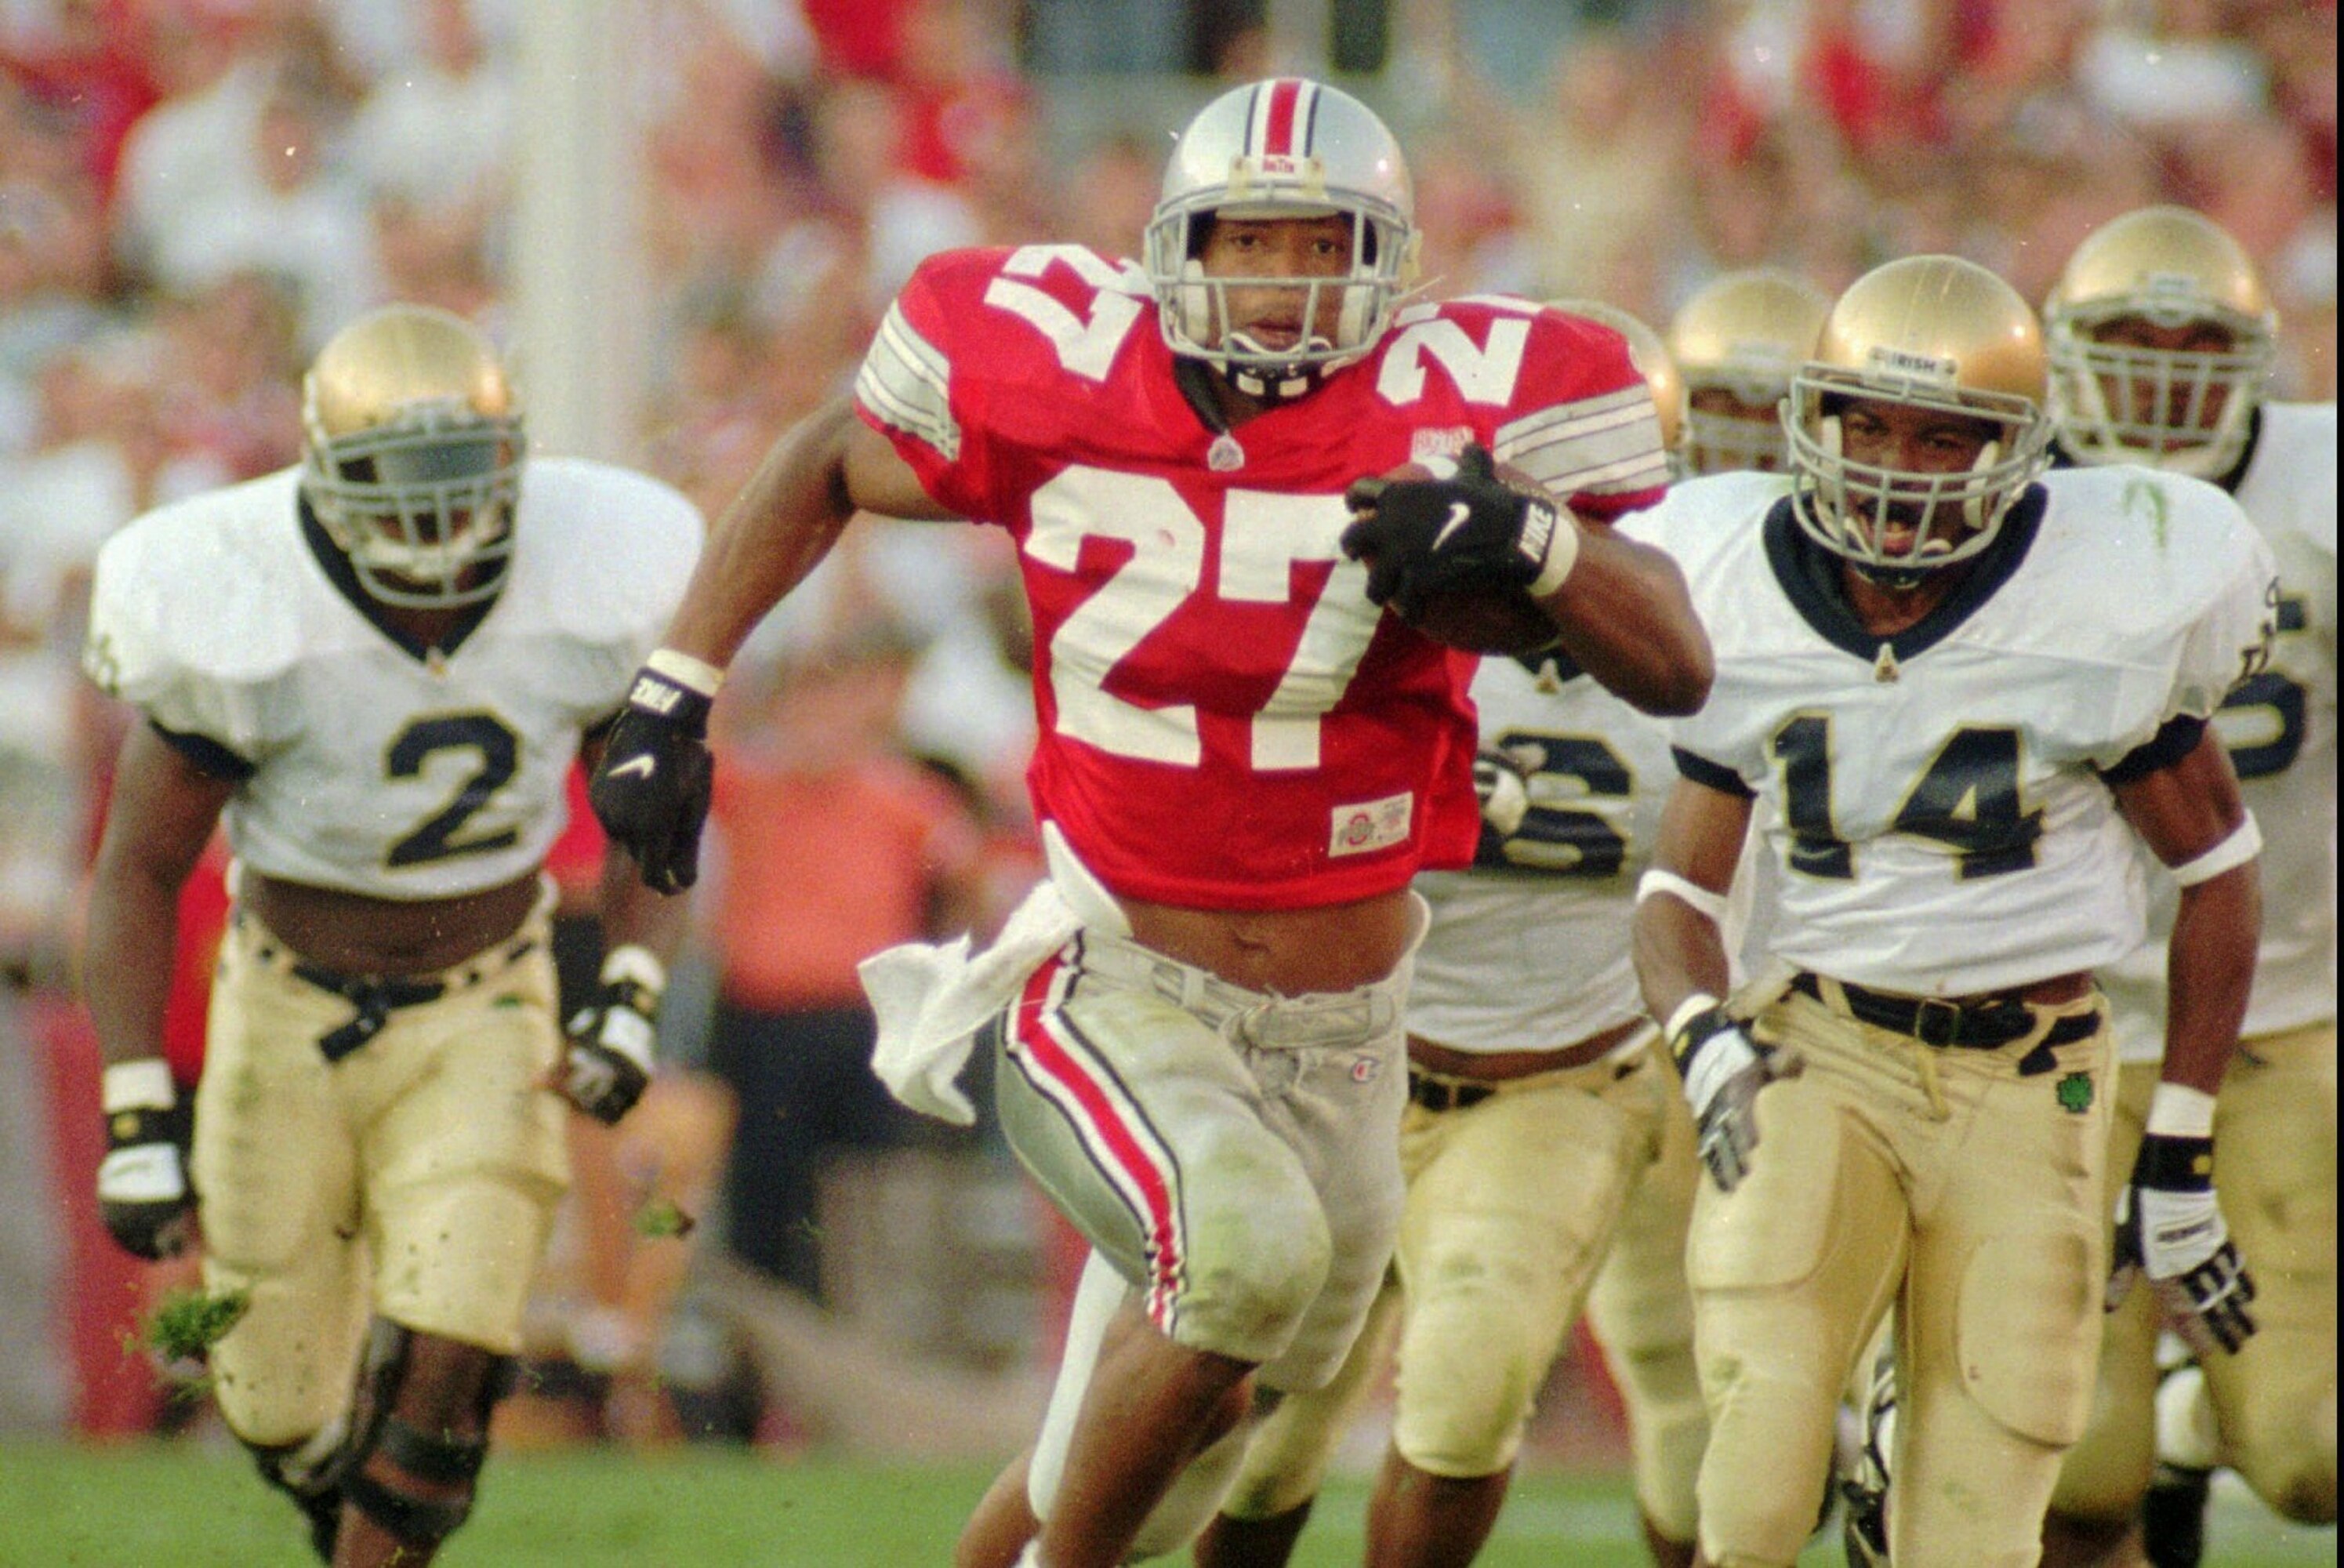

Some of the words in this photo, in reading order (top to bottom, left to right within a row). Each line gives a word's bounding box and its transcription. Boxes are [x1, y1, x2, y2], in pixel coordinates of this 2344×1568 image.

[1891, 352, 1937, 372] IRISH
[1519, 503, 1554, 564] NIKE
[1022, 463, 1383, 771] 27
[383, 708, 524, 873] 2
[1767, 710, 2048, 882] 14
